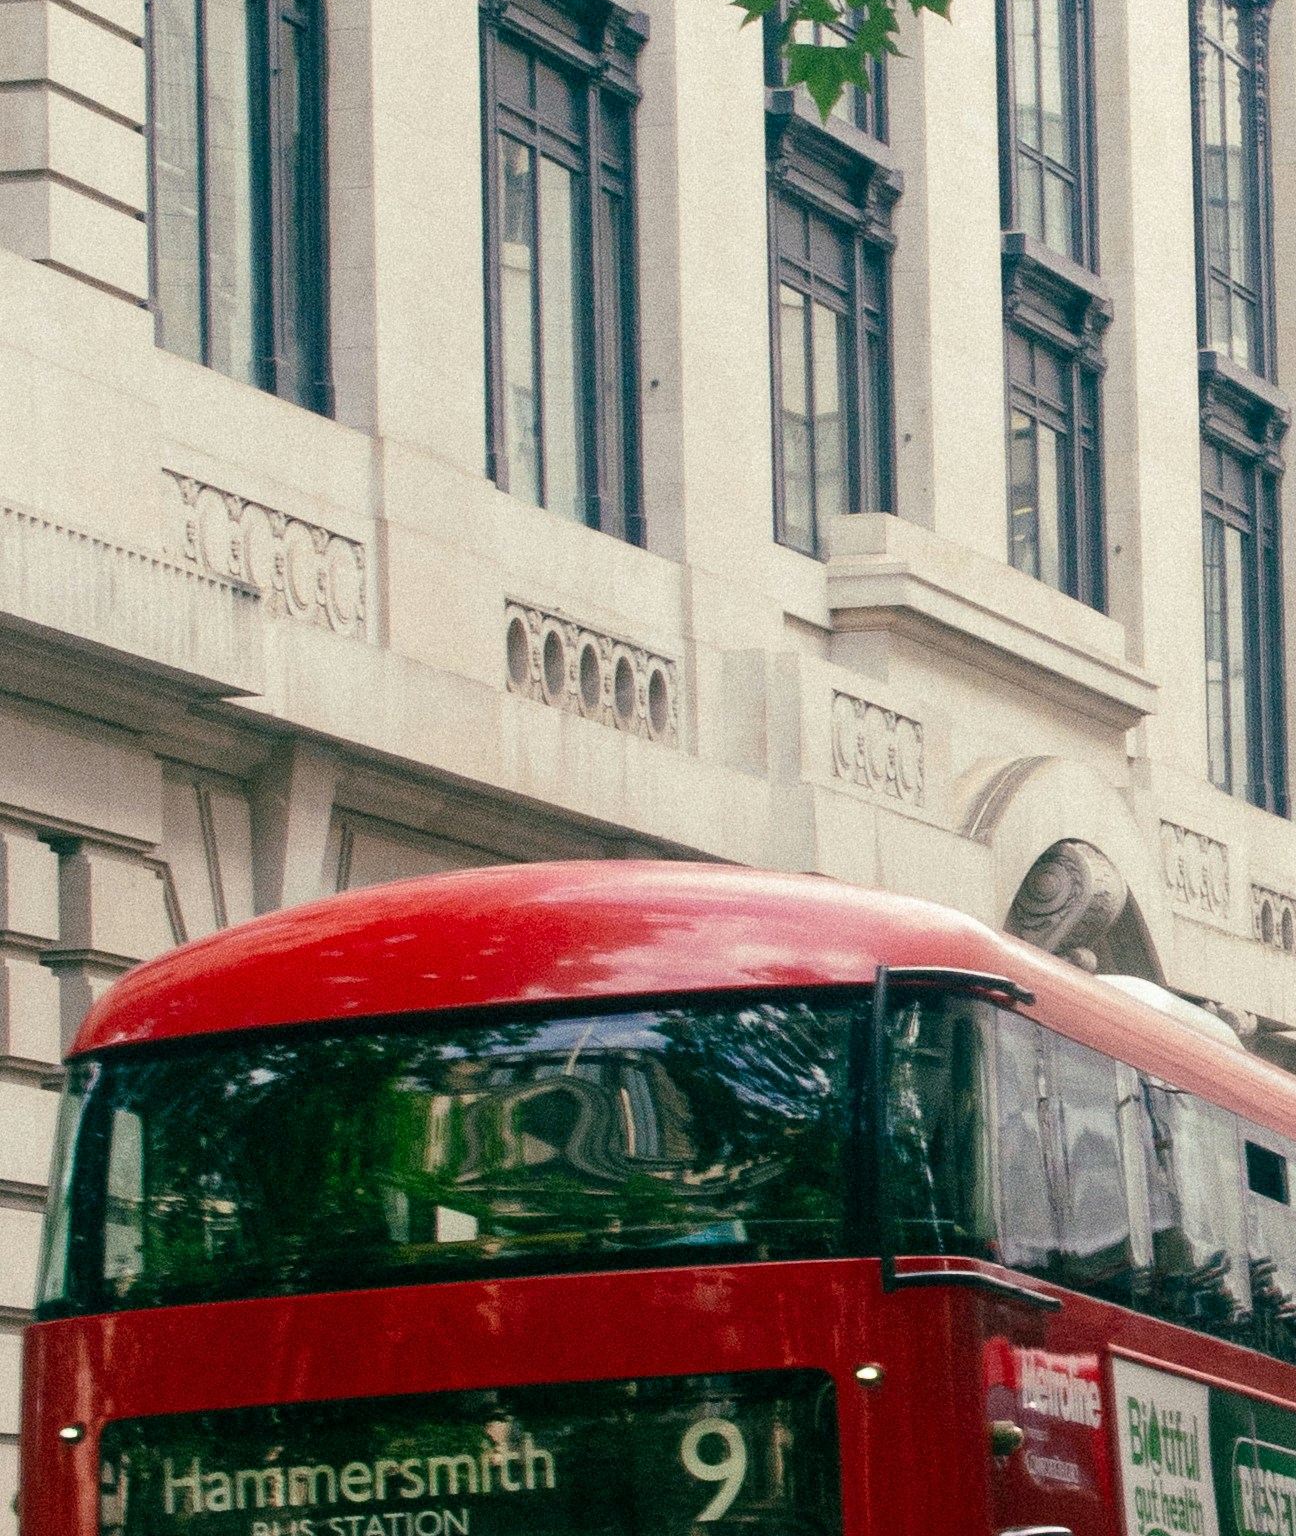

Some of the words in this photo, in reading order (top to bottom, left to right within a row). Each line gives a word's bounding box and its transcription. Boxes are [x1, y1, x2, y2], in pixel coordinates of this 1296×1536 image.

[163, 1432, 556, 1515] Hammersmith
[680, 1417, 747, 1522] 9
[1135, 1478, 1160, 1535] gut
[1160, 1480, 1206, 1536] health
